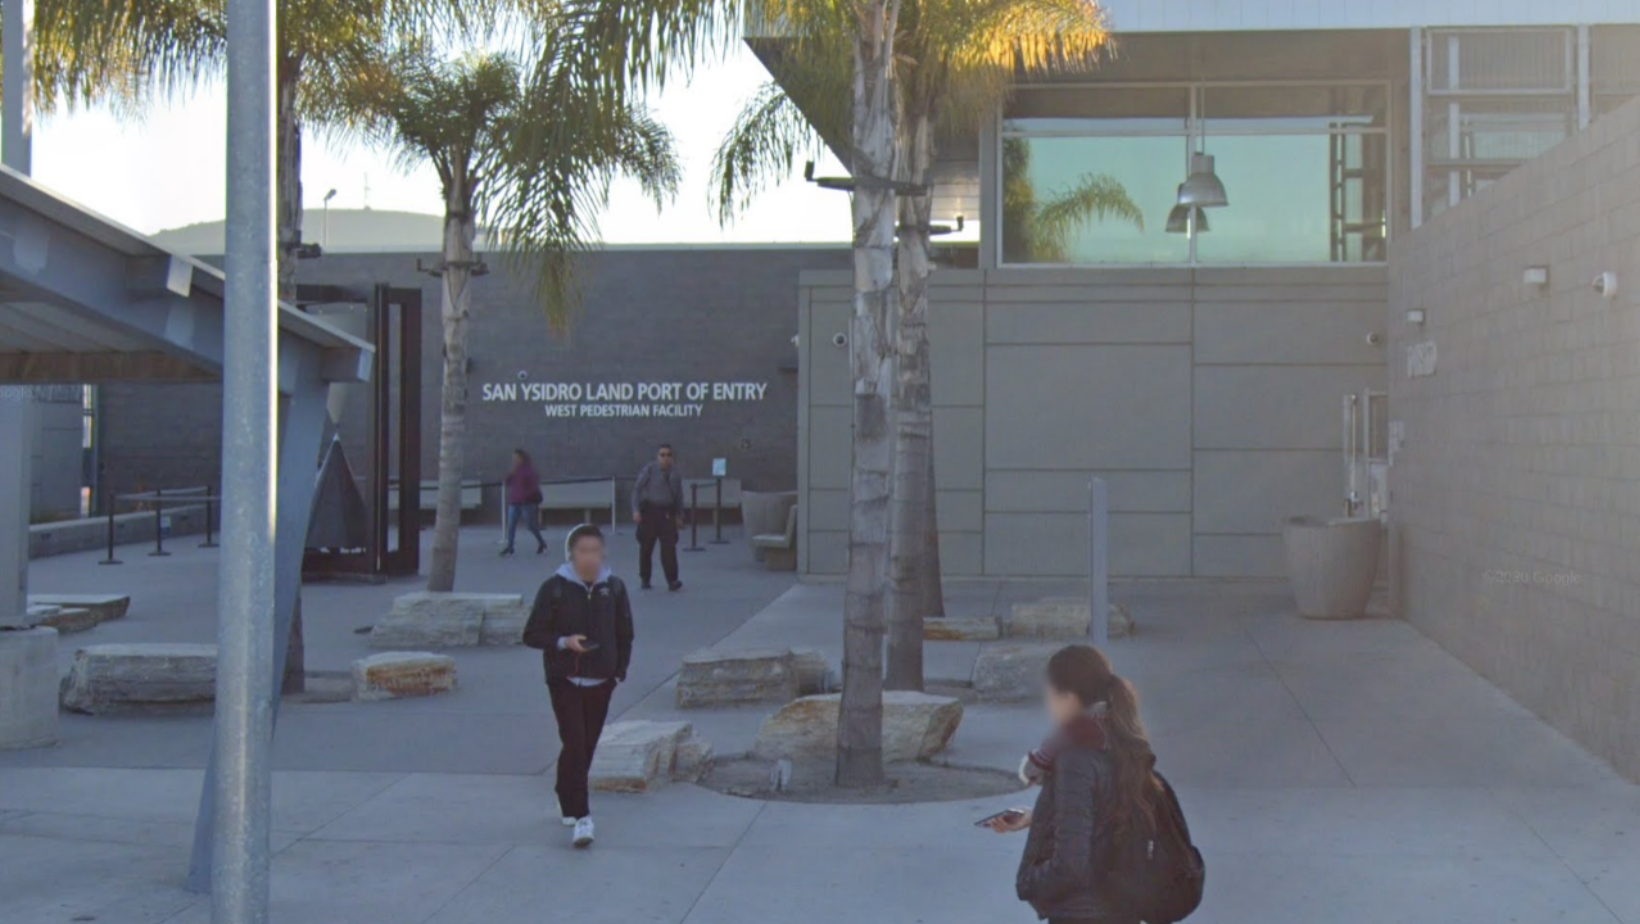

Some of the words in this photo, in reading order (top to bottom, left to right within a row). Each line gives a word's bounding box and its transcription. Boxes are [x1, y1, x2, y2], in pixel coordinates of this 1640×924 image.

[482, 382, 517, 401] SAN
[520, 382, 582, 401] YSIDRO
[586, 382, 634, 401] LAND
[637, 382, 682, 401] PORT
[686, 382, 709, 401] OF
[713, 382, 767, 401] ENTRY
[545, 404, 577, 417] WEST
[580, 404, 650, 417] PEDESTRIAN
[652, 404, 703, 417] FACILITY
